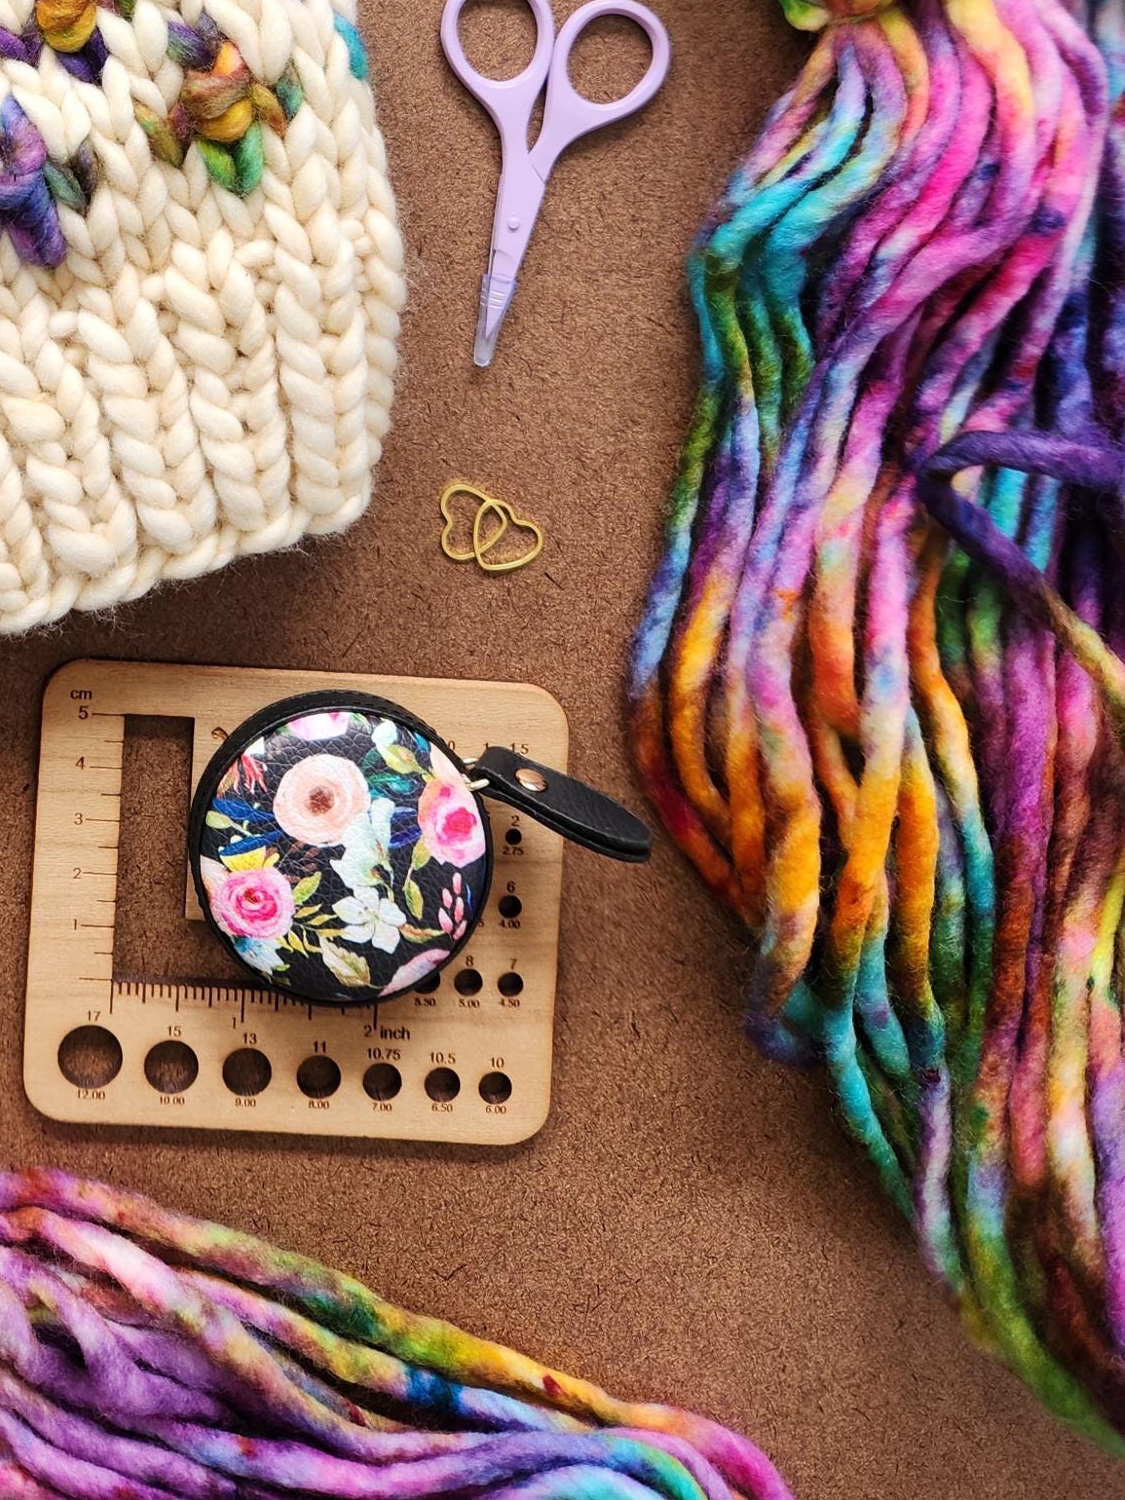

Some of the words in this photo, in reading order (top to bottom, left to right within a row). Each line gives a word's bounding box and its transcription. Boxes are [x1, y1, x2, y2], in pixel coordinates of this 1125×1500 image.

[70, 689, 93, 700] cm
[78, 705, 89, 720] 5
[75, 756, 86, 771] 4
[74, 812, 84, 826] 3
[511, 815, 520, 826] 2
[502, 847, 524, 855] 2.75
[72, 867, 82, 880] 2
[507, 881, 516, 892] 6
[499, 920, 521, 929] 4.00
[465, 956, 474, 967] 8
[510, 959, 517, 969] 7
[414, 998, 436, 1007] 5.50
[459, 999, 480, 1009] 5.00
[499, 1000, 521, 1008] 4.50
[87, 1010, 102, 1021] 17
[231, 1017, 237, 1029] 1
[167, 1025, 182, 1037] 15
[363, 1025, 373, 1038] 2
[379, 1025, 411, 1041] inch
[242, 1033, 258, 1045] 13
[313, 1041, 327, 1053] 11
[366, 1048, 402, 1061] 10.75
[429, 1052, 457, 1065] 10.5
[490, 1057, 505, 1069] 10
[76, 1089, 106, 1101] 12.00
[159, 1096, 186, 1106] 10.00
[234, 1098, 257, 1108] 9.00
[308, 1100, 330, 1110] 8.00
[372, 1102, 393, 1113] 7.00
[431, 1103, 454, 1113] 6.50
[485, 1105, 508, 1116] 6.00
